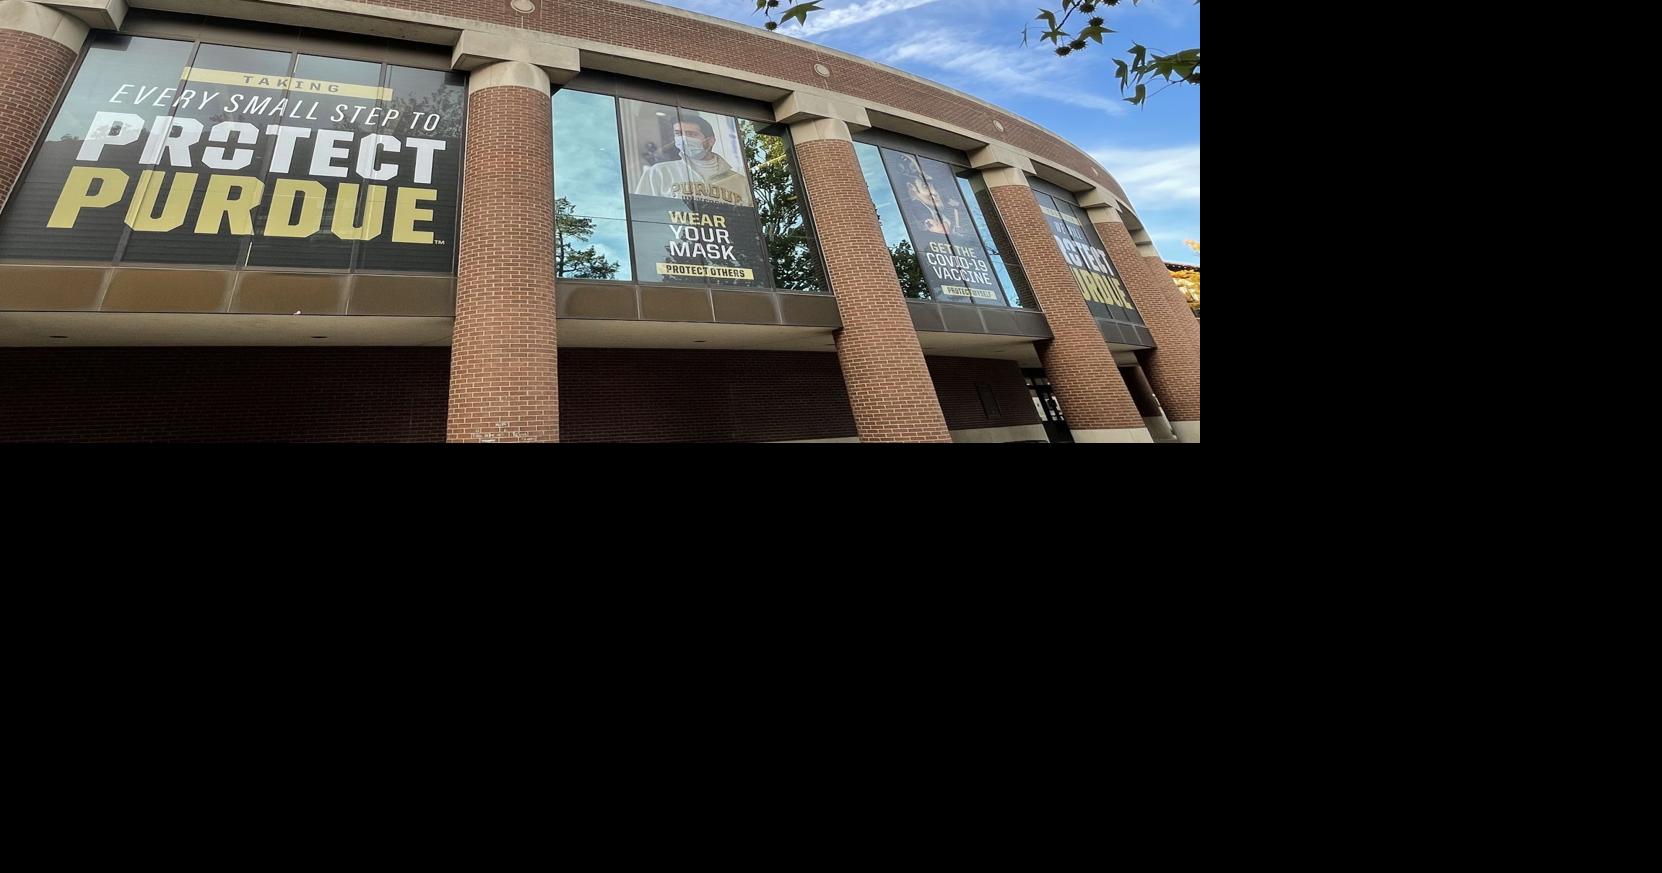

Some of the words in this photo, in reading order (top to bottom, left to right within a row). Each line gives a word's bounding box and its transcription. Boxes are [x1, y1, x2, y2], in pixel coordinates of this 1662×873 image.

[243, 75, 340, 93] TAKING
[109, 84, 219, 110] EVERY
[224, 94, 319, 120] SMALL
[331, 104, 399, 127] STEP
[410, 112, 440, 132] TO
[76, 111, 446, 184] PROTECT
[47, 166, 438, 244] PURDUE
[668, 210, 727, 228] WEAR
[669, 225, 731, 244] YOUR
[669, 240, 737, 261] MASK
[929, 241, 953, 254] GET
[954, 245, 977, 258] THE
[666, 264, 708, 275] PROTECT
[710, 267, 745, 278] OTHERS
[926, 252, 989, 272] COVID-19
[933, 265, 993, 285] VACCINE
[1069, 265, 1134, 310] URDUE
